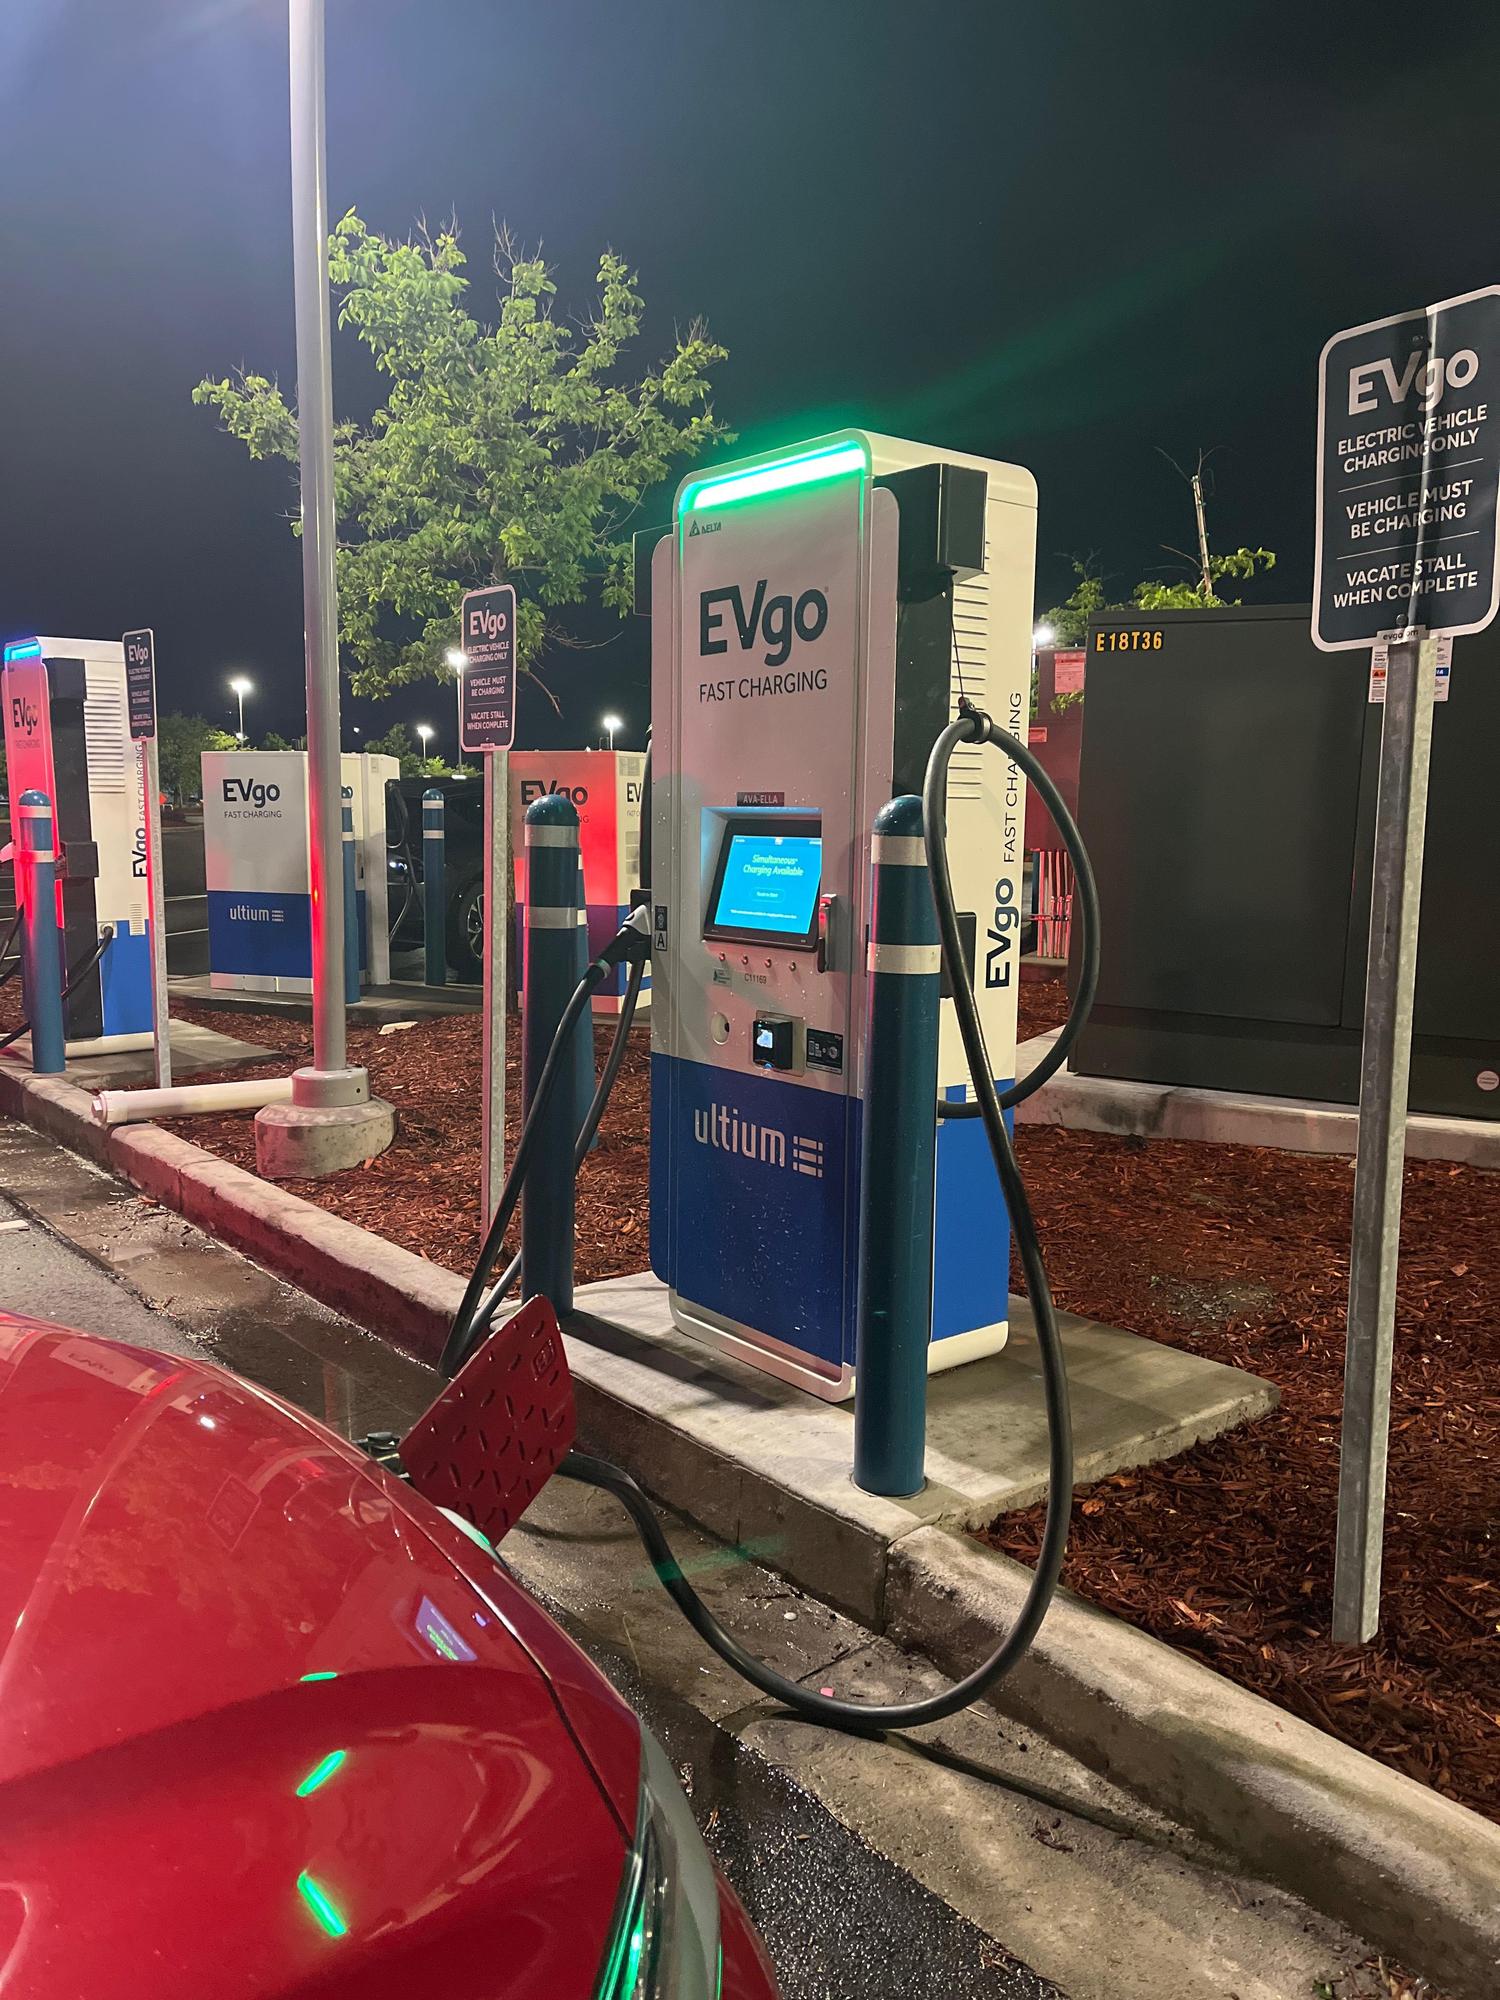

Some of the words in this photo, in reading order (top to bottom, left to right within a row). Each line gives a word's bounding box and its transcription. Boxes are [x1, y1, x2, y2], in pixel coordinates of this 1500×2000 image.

[1348, 349, 1479, 416] EVgo
[1337, 424, 1416, 456] ELECTRIC
[1419, 404, 1488, 436] VEHICLE
[1343, 440, 1430, 474] CHARGING
[1431, 427, 1480, 453] ONLY
[1346, 492, 1419, 520] VEHICLE
[1422, 479, 1474, 505] MUST
[1350, 521, 1371, 540] BE
[1373, 502, 1467, 535] CHARGING
[1346, 562, 1411, 587] VACATE
[1414, 553, 1467, 576] STALL
[1333, 587, 1383, 609] WHEN
[1386, 570, 1478, 600] COMPLETE
[470, 609, 507, 640] EVgo
[700, 579, 829, 667] EVgo
[1382, 629, 1419, 641] evgoom
[128, 644, 149, 665] EVgo
[494, 651, 508, 661] ONLY
[1096, 631, 1163, 652] E18T36
[470, 677, 491, 687] VEHICLE
[491, 675, 507, 685] MUST
[471, 689, 478, 697] BE
[478, 686, 505, 696] CHARGING
[700, 680, 736, 703] FAST
[738, 668, 828, 699] CHARGING
[12, 697, 39, 736] EVgo
[466, 721, 482, 730] WHEN
[482, 719, 509, 730] COMPLETE
[470, 711, 490, 720] VACATE
[490, 710, 506, 719] STALL
[1005, 691, 1022, 808] CHAING
[222, 778, 281, 809] EVgo
[742, 793, 779, 804] AVA-ELLA
[224, 811, 241, 819] FAST
[242, 810, 282, 819] CHARGING
[1003, 814, 1018, 864] FAST
[743, 864, 773, 877] Charging
[772, 865, 804, 876] Available
[229, 904, 270, 921] ultium
[656, 932, 666, 948] A
[985, 877, 1020, 989] EVgo
[694, 1103, 786, 1168] ultium
